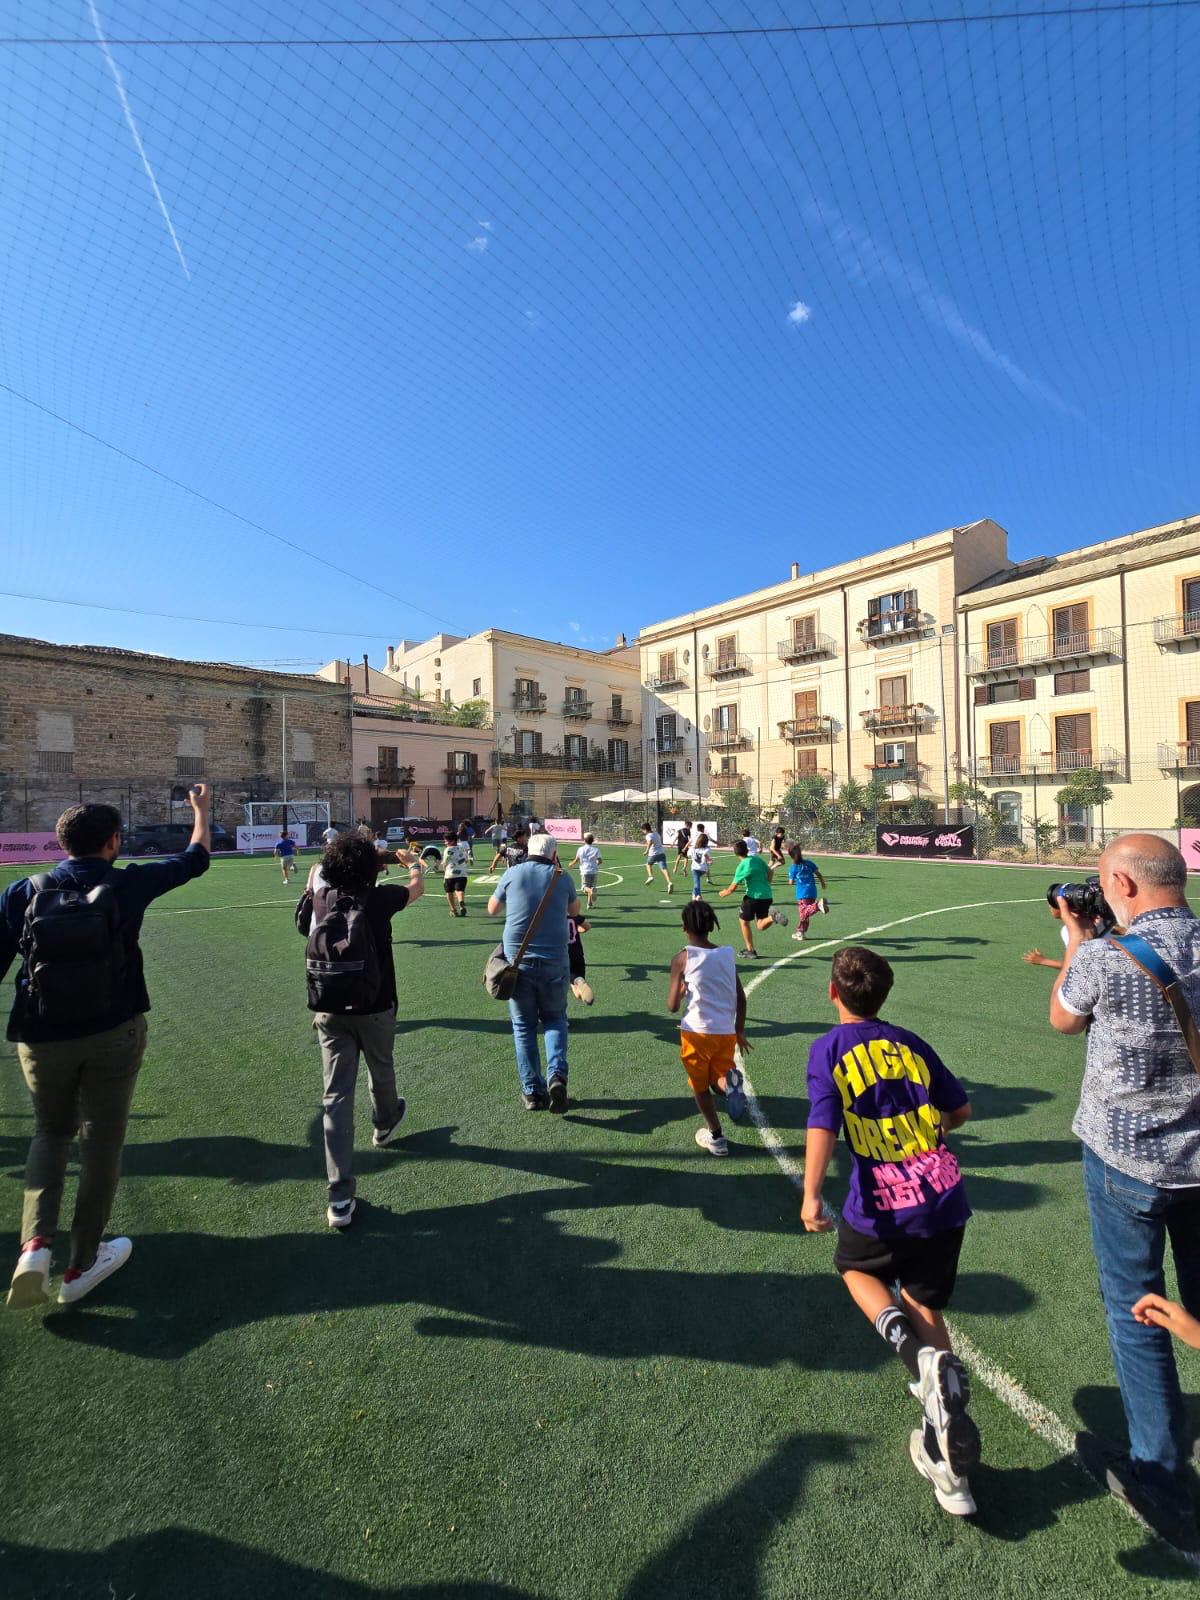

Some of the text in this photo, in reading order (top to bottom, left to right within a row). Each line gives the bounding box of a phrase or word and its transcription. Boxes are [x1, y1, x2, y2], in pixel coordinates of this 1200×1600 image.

[833, 1039, 930, 1110] HIGH
[872, 1163, 906, 1188] NO
[872, 1178, 926, 1211] JUST
